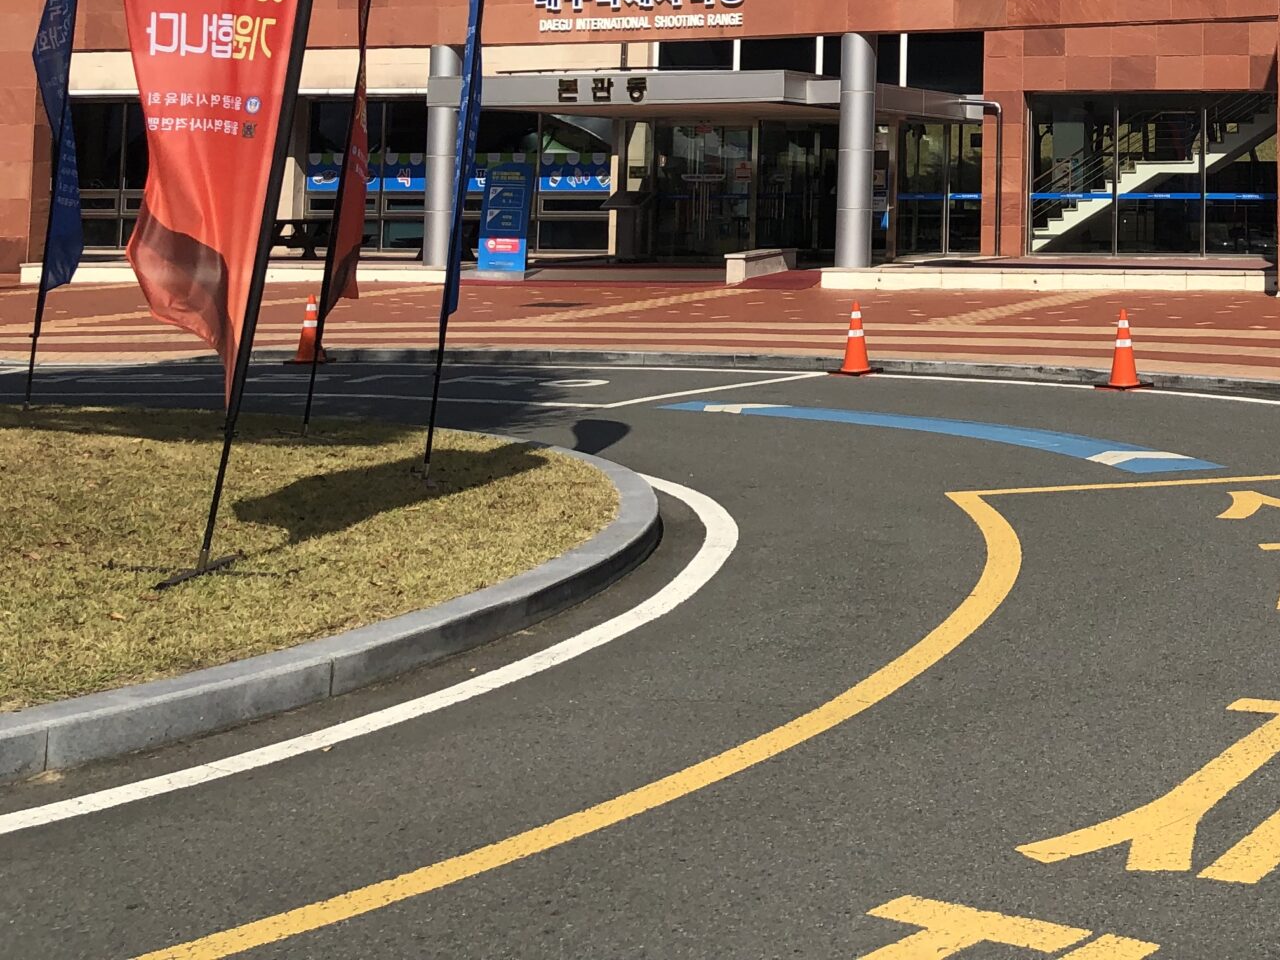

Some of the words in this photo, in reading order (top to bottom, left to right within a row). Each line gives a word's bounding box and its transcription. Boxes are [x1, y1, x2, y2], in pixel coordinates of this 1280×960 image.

[539, 19, 573, 32] DAEGU
[576, 16, 651, 30] INTERNATIONAL
[654, 14, 704, 28] SHOOTING
[707, 13, 743, 26] RANGE
[557, 76, 647, 102] 본관동
